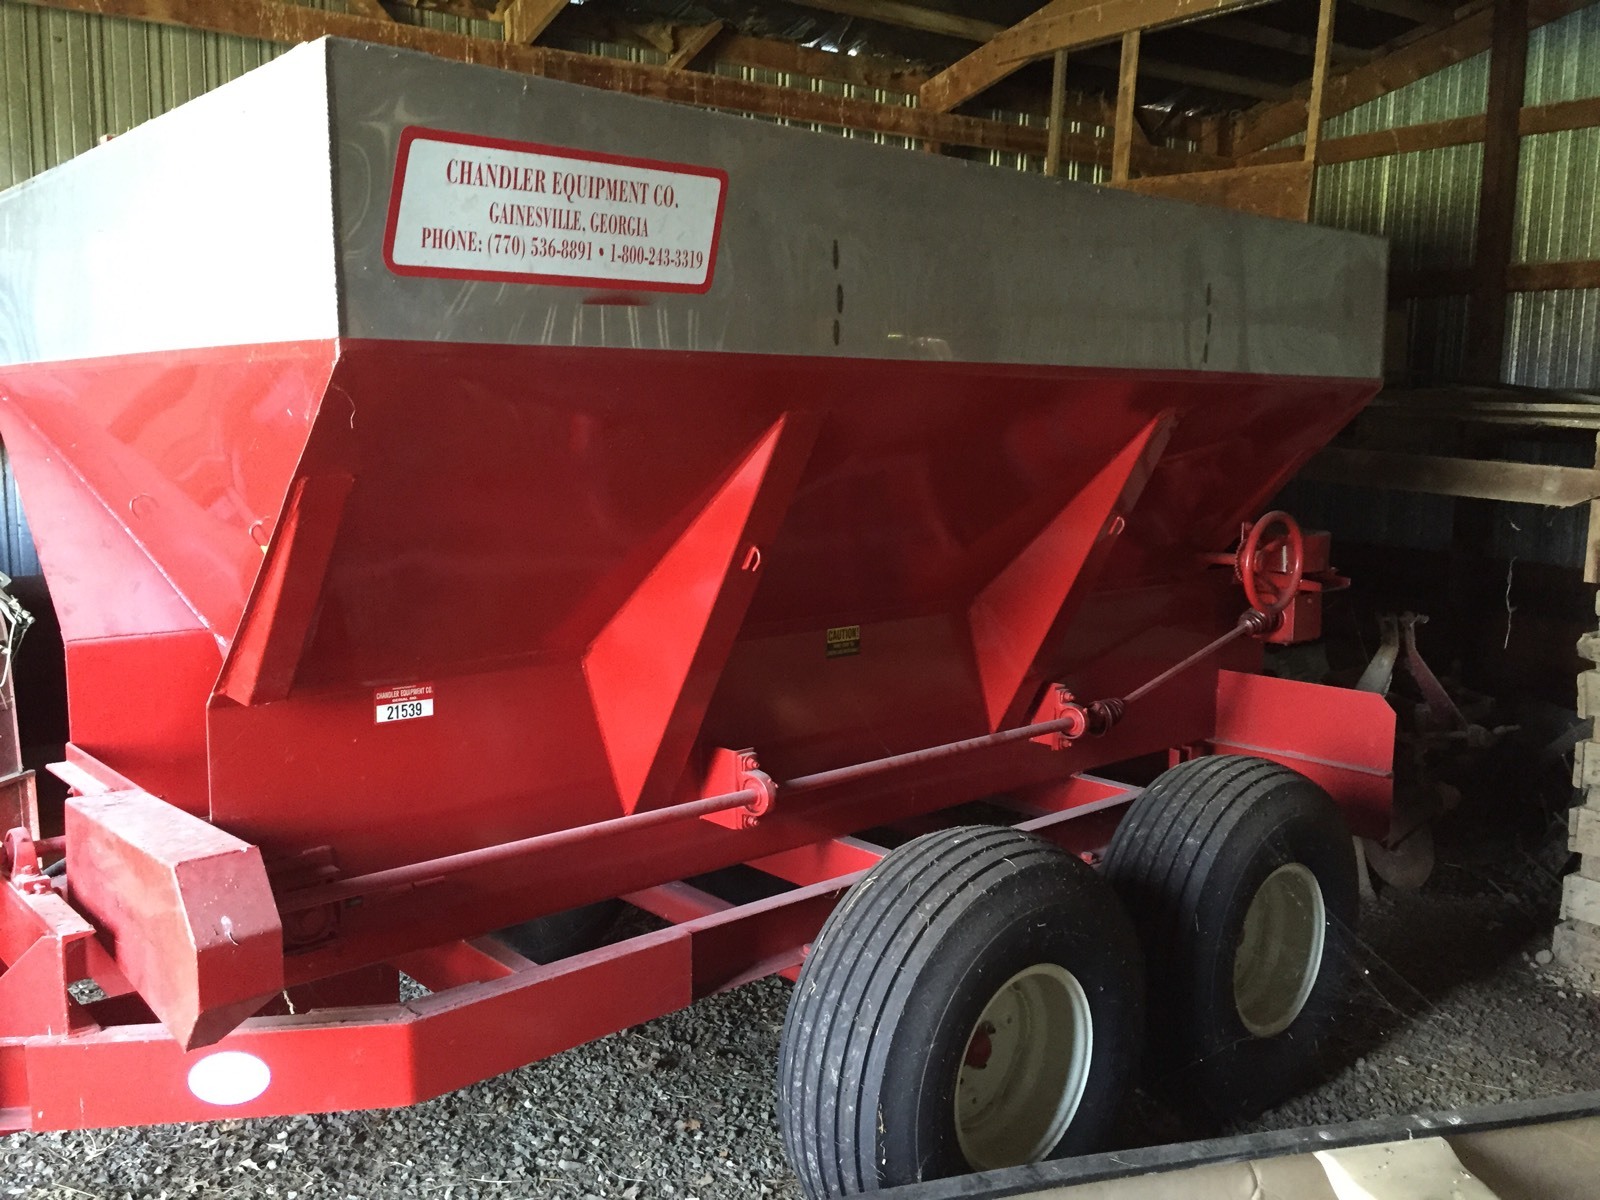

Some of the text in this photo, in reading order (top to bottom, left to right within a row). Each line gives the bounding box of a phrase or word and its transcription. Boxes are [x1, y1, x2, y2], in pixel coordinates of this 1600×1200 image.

[446, 158, 679, 208] CHANDLER EQUIPMENT CO.
[590, 212, 649, 238] GEORGIA
[421, 226, 703, 269] PHONE: (770) 536-8891 1-800-243-3319
[376, 690, 399, 700] CHANDLER
[400, 687, 425, 697] EQUIPMENT
[387, 702, 422, 720] 21539
